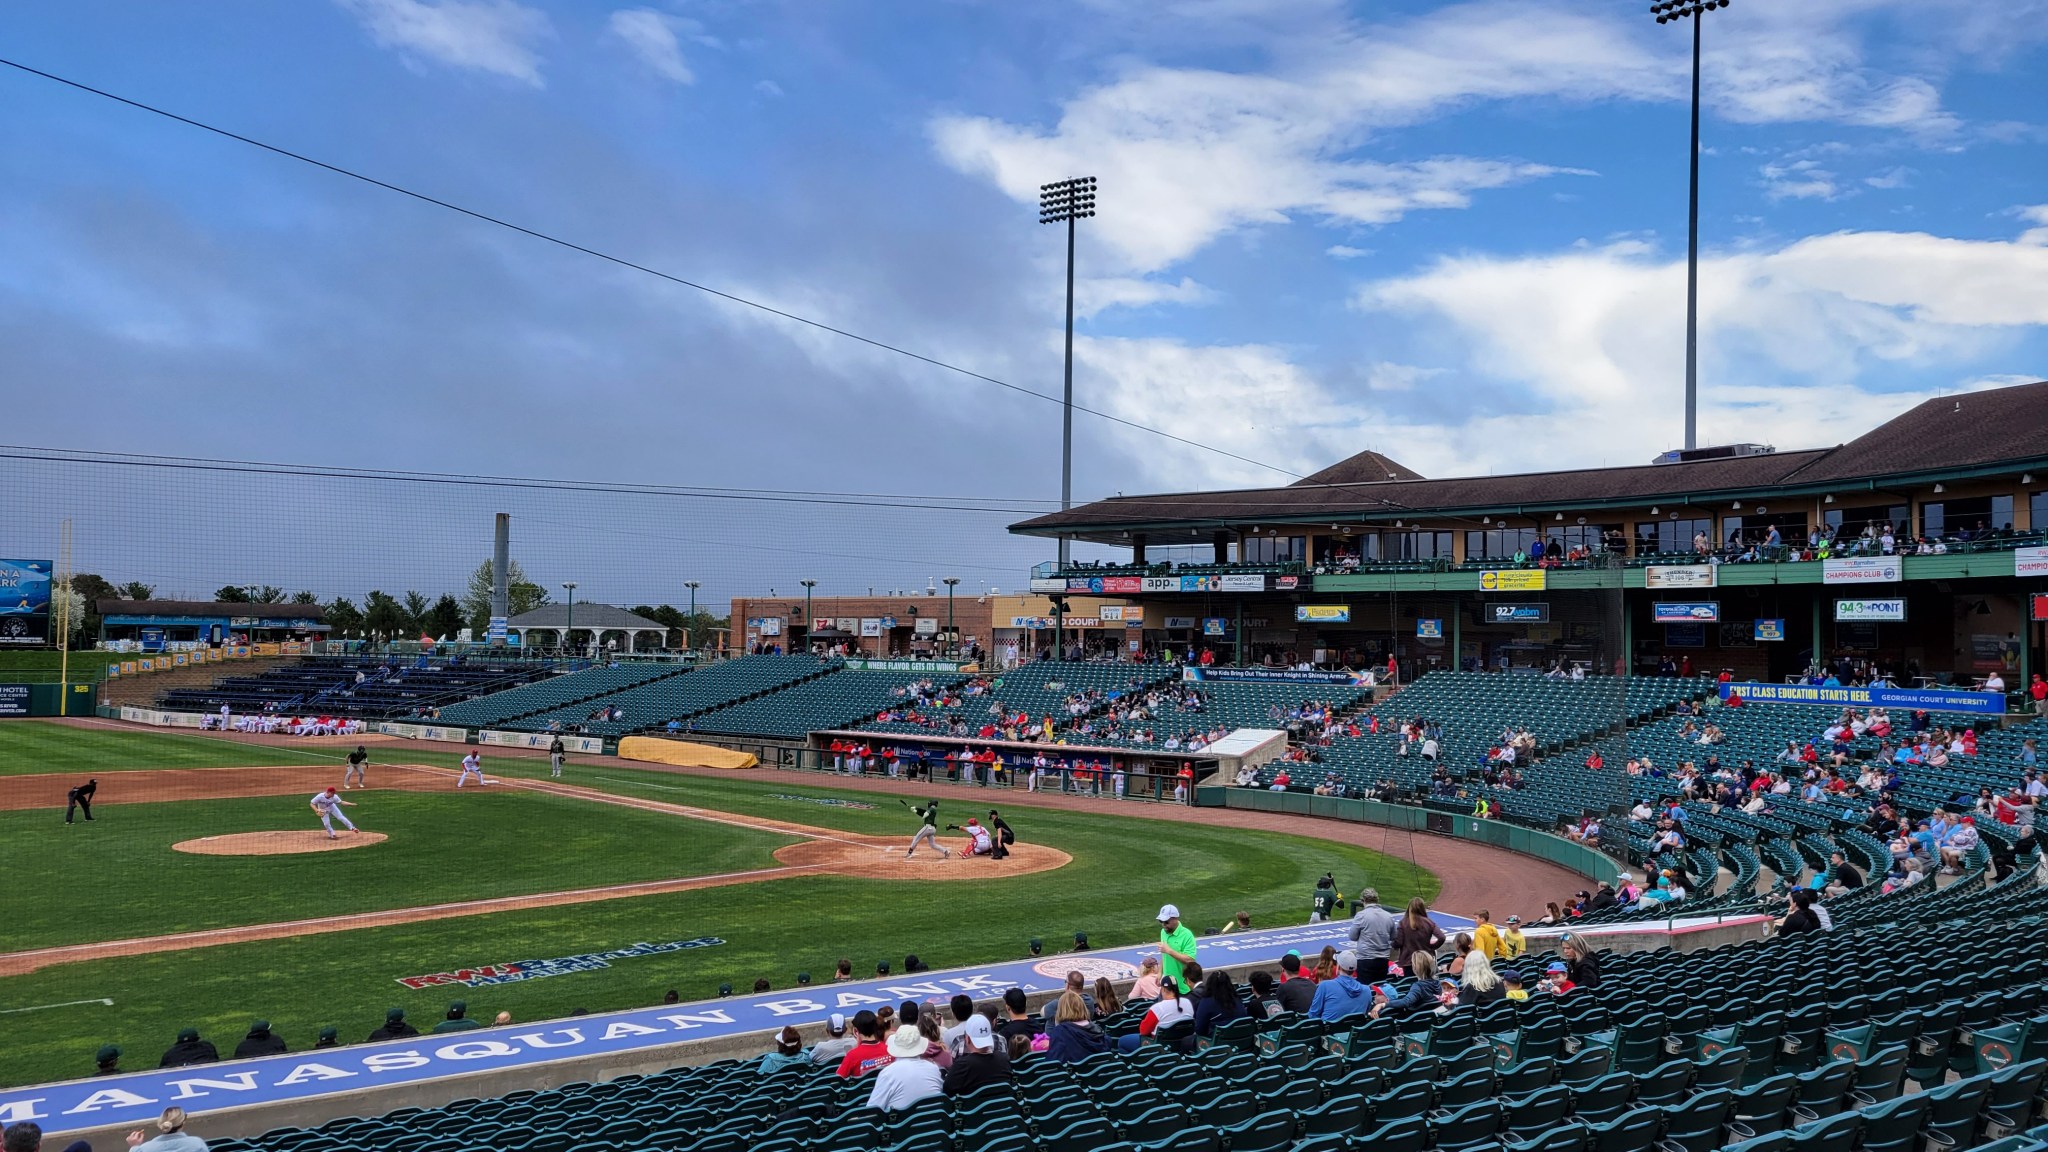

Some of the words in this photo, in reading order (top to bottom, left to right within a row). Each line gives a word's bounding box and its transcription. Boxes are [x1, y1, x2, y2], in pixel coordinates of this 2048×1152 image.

[12, 569, 20, 578] A
[1825, 571, 1863, 579] CHAMPIONS
[1864, 570, 1881, 578] CLUB
[0, 578, 17, 587] RK
[1148, 579, 1175, 589] app.
[1871, 602, 1900, 613] POINT
[262, 619, 285, 627] Pizza
[291, 618, 314, 628] Soda
[1042, 618, 1067, 627] FOD
[1068, 618, 1100, 627] COURT
[866, 661, 888, 670] WHERE
[888, 661, 910, 671] FLAVOR
[911, 662, 925, 671] GETS
[926, 662, 935, 671] ITS
[936, 662, 957, 672] WINGS
[1206, 669, 1218, 677] Help
[1230, 670, 1244, 678] Bring
[1308, 672, 1328, 680] Shining
[74, 685, 89, 693] 325
[1752, 686, 1776, 699] CLASS
[1778, 687, 1818, 700] EDUCATION
[1819, 689, 1849, 701] STARTS
[1850, 690, 1873, 703] HERE.
[1881, 694, 1918, 702] GEORGIAN
[1945, 697, 1988, 706] UNIVERSITY
[1314, 896, 1325, 908] 52
[753, 974, 1019, 1017] BANK
[979, 983, 1040, 997] 184
